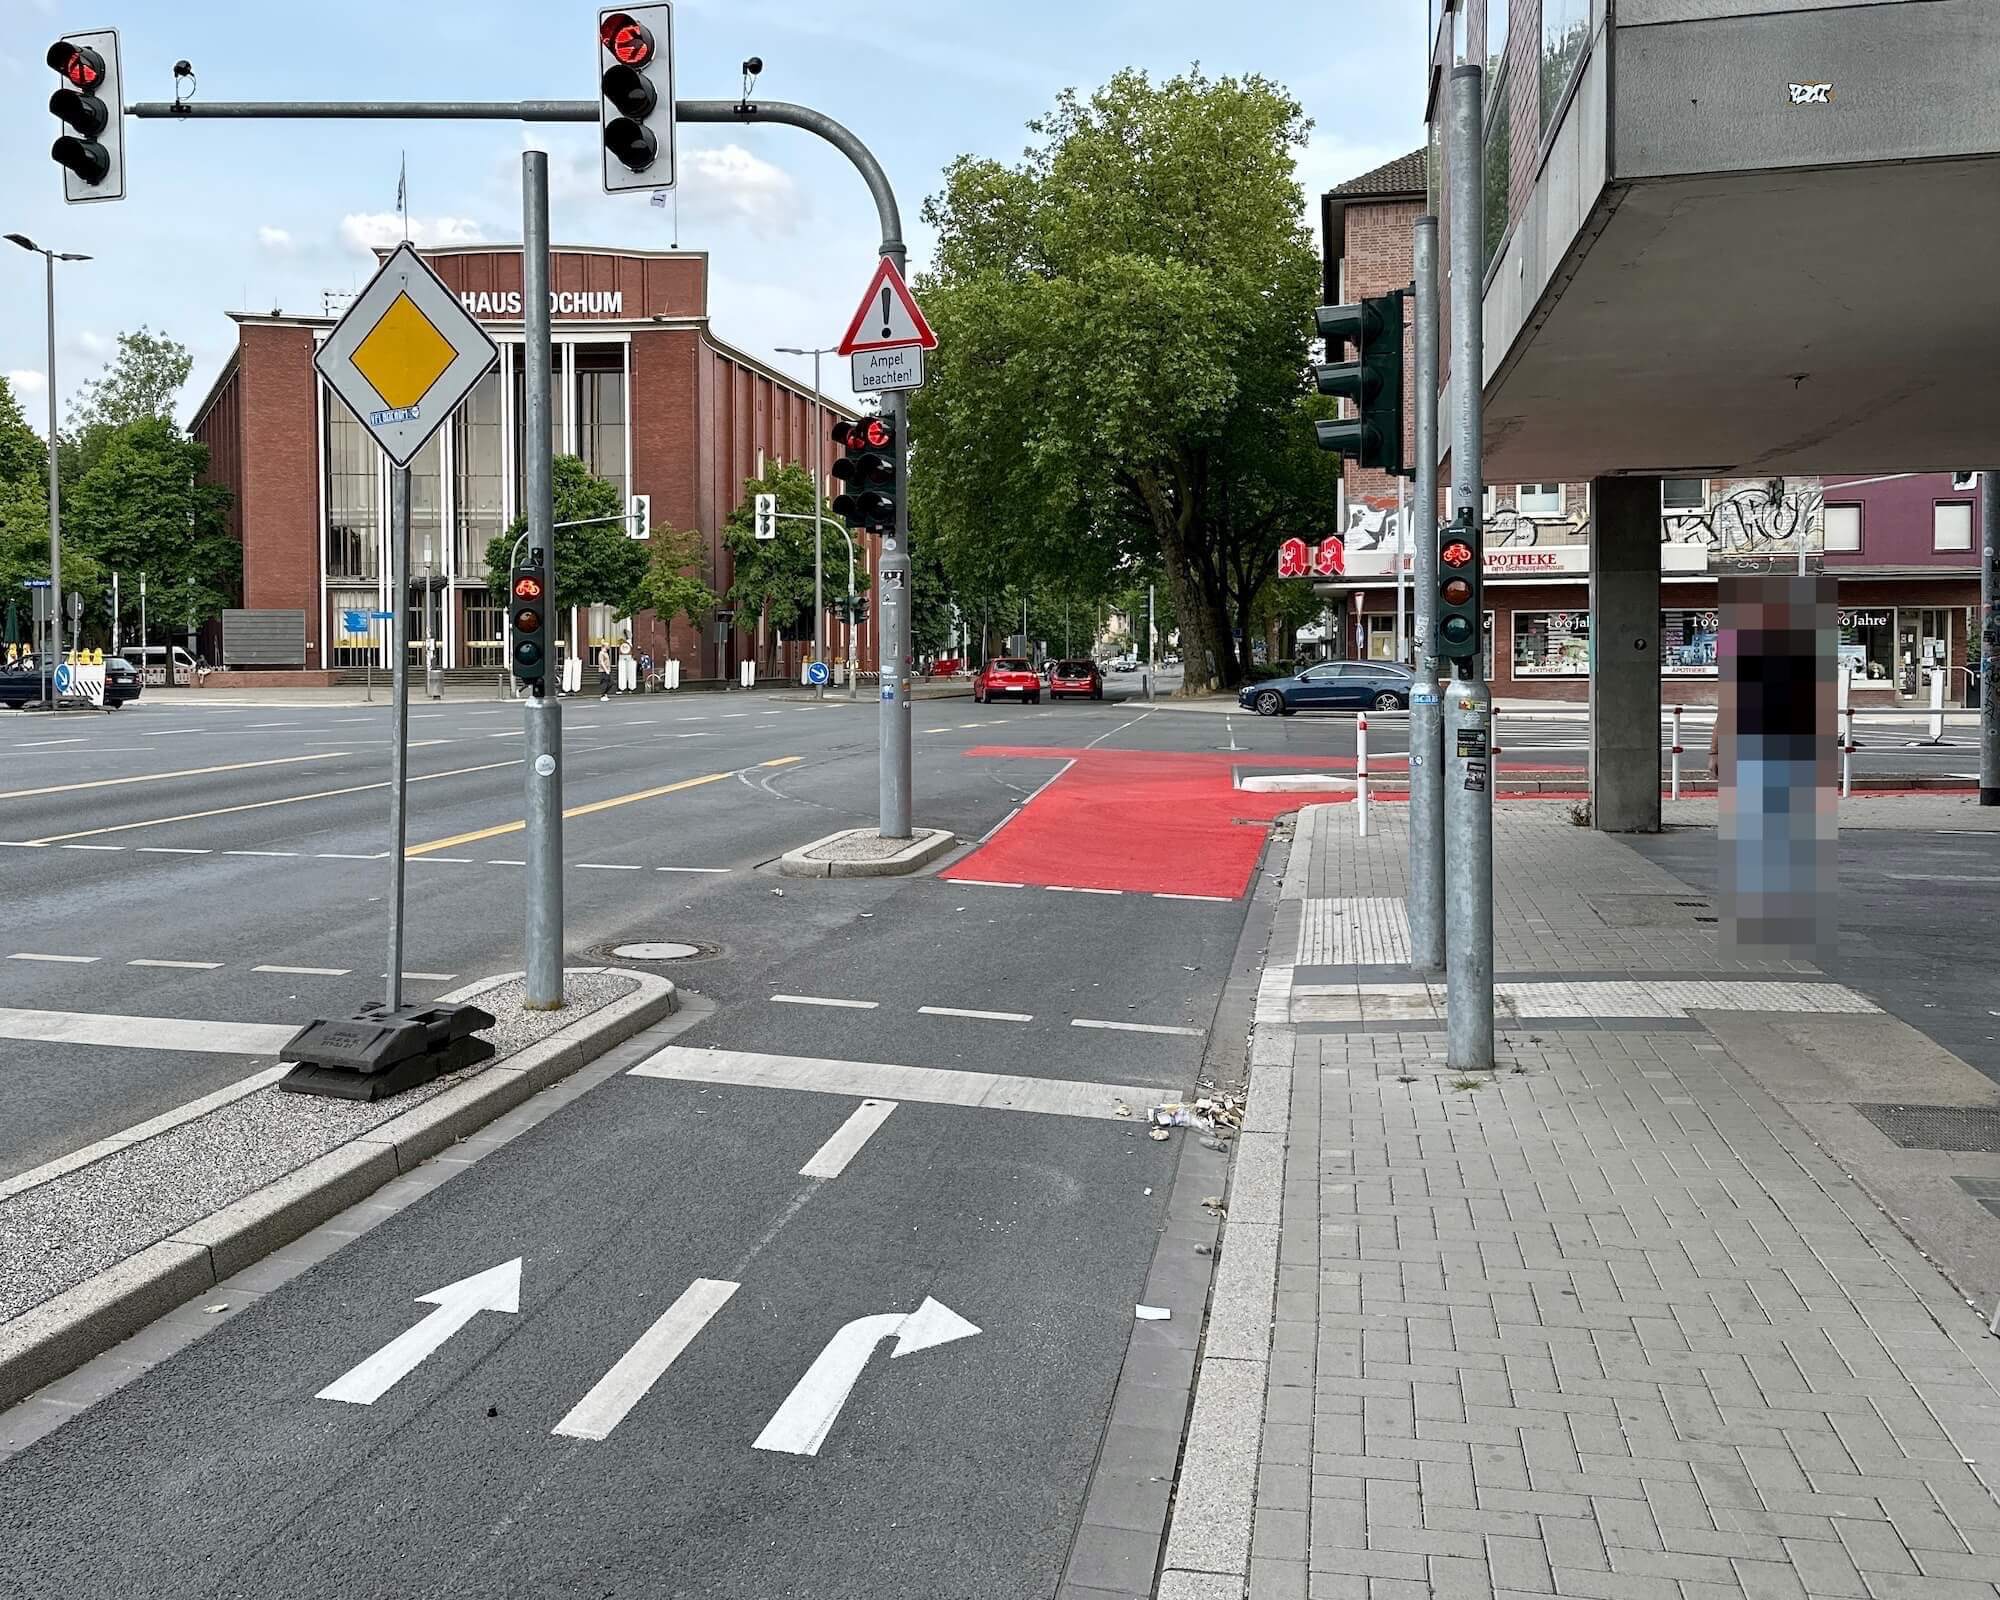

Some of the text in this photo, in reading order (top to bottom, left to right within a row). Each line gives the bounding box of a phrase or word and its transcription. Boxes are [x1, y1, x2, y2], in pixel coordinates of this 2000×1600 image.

[549, 291, 622, 314] OCHUM
[870, 352, 904, 368] Ampel
[863, 368, 912, 386] beachten!
